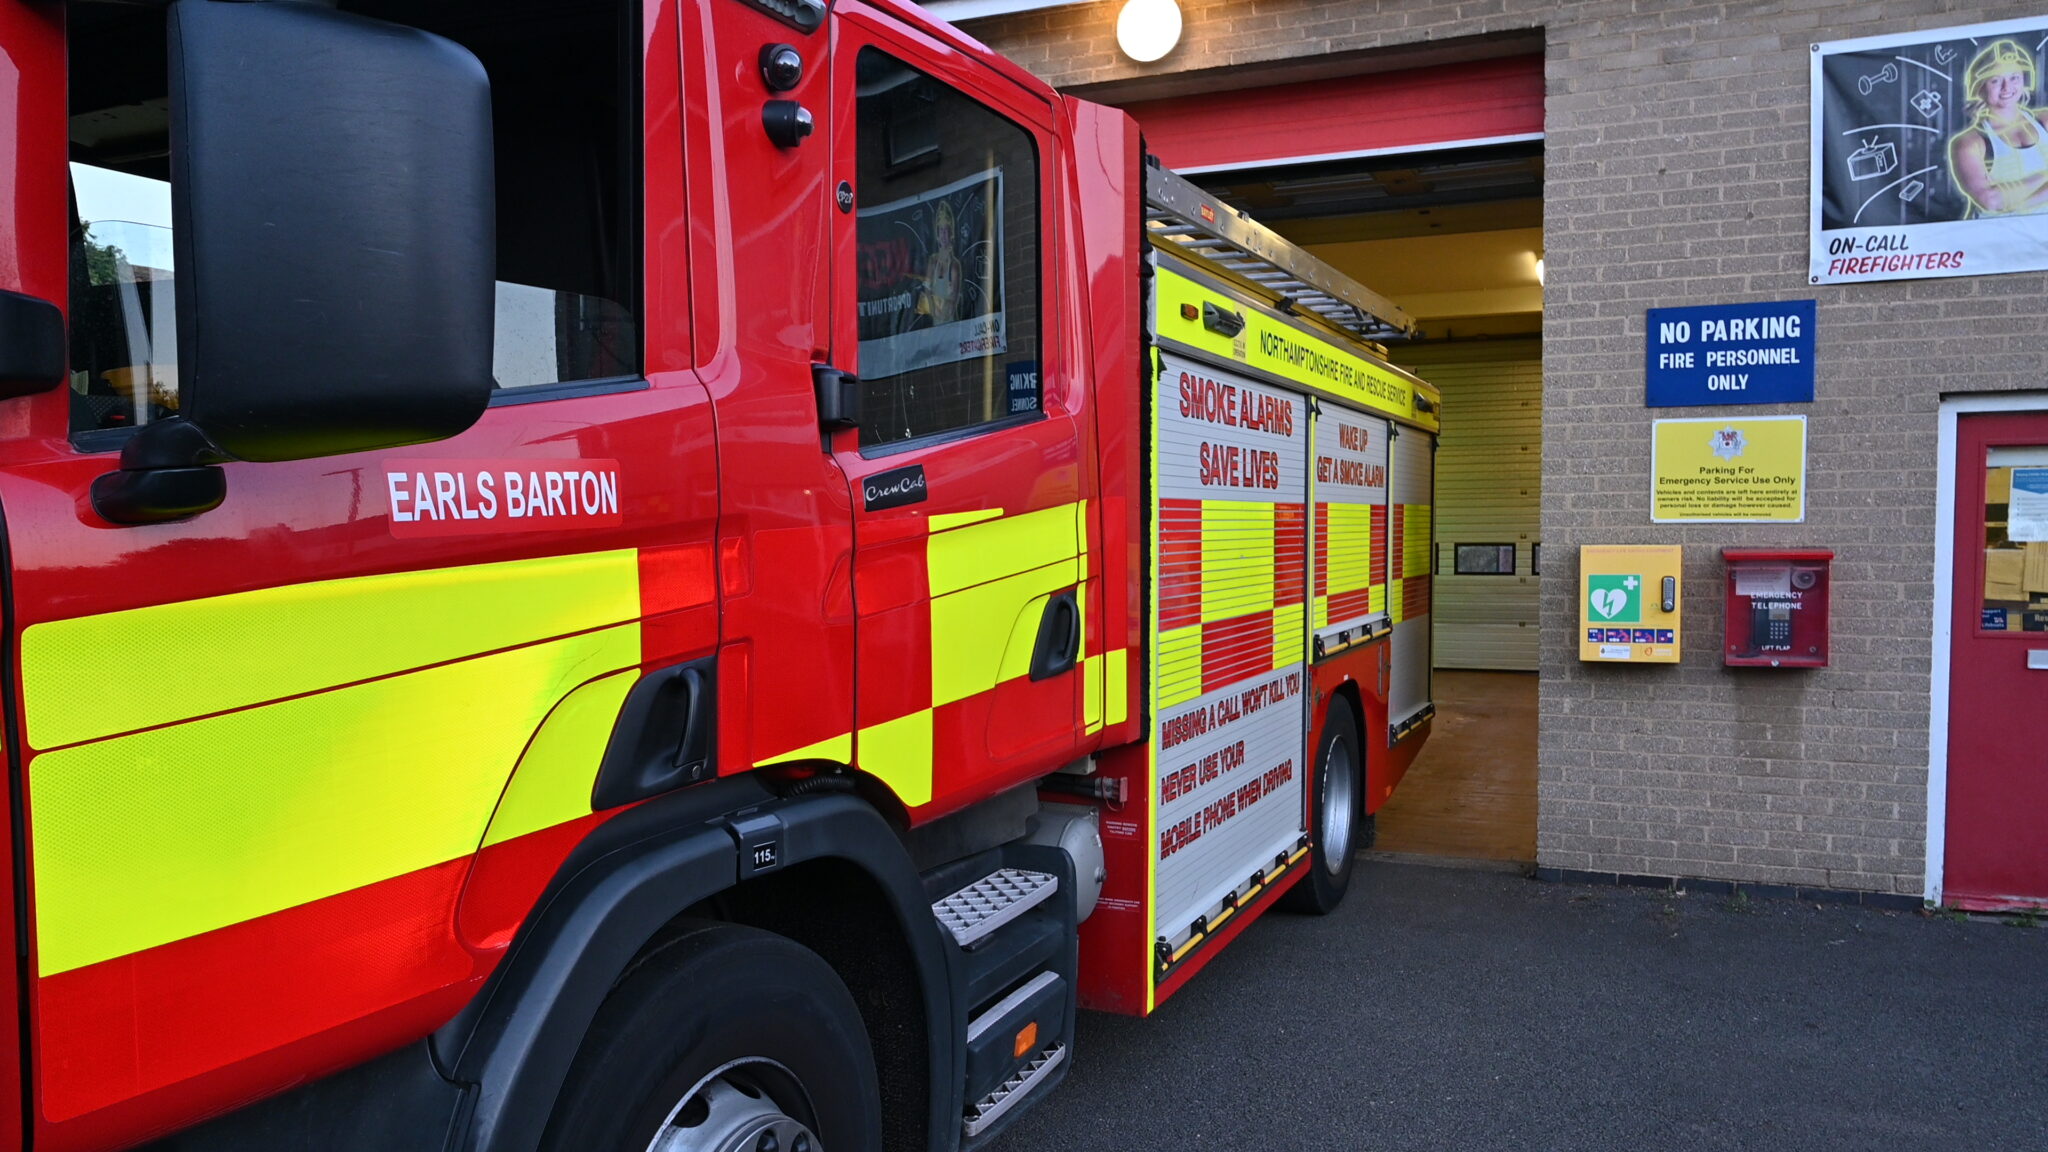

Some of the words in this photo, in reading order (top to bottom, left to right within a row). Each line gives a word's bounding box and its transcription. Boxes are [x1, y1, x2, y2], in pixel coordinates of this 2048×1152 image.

[1828, 234, 1909, 256] ON-CALL
[1828, 251, 1964, 276] FIREFIGHTERS
[1660, 321, 1690, 344] NO
[1701, 315, 1800, 342] PARKING
[1260, 329, 1339, 380] NORTHAMPTONSHIRE
[1340, 363, 1353, 387] FIRE
[1354, 369, 1366, 391] AND
[1366, 374, 1386, 399] RESCUE
[1659, 352, 1694, 369] FIRE
[1706, 348, 1800, 367] PERSONNEL
[1707, 374, 1748, 390] ONLY
[1179, 372, 1236, 426] SMOKE
[1240, 390, 1293, 438] ALARMS
[1339, 422, 1358, 451] WAKE
[1359, 428, 1368, 452] UP
[1200, 441, 1239, 486] SAVE
[1242, 448, 1279, 490] LIVES
[1317, 455, 1332, 483] GET
[1333, 458, 1339, 484] A
[1340, 459, 1363, 486] SMOKE
[1364, 463, 1385, 488] ALARM
[1699, 466, 1736, 475] Parking
[1738, 466, 1755, 474] For
[1659, 477, 1711, 486] Emergency
[1714, 476, 1749, 484] Service
[1752, 476, 1770, 484] Use
[1773, 475, 1796, 485] Only
[387, 470, 498, 522] EARLS
[504, 470, 618, 517] BARTON
[1751, 591, 1803, 599] EMERGENCY
[1752, 602, 1802, 610] TELEPHONE
[1161, 706, 1207, 750] MISSING
[1208, 704, 1215, 732] A
[1218, 695, 1240, 726] CALL
[1242, 684, 1268, 716] WON'T
[1269, 678, 1285, 705] KILL
[1285, 671, 1300, 697] YOU
[1161, 763, 1197, 806] NEVER
[1199, 751, 1218, 785] USE
[1220, 740, 1245, 774] YOUR
[1160, 811, 1201, 860] MOBILE
[1203, 791, 1235, 834] PHONE
[1237, 775, 1262, 812] WHEN
[1263, 758, 1293, 797] DRIVING
[754, 848, 771, 864] 115
